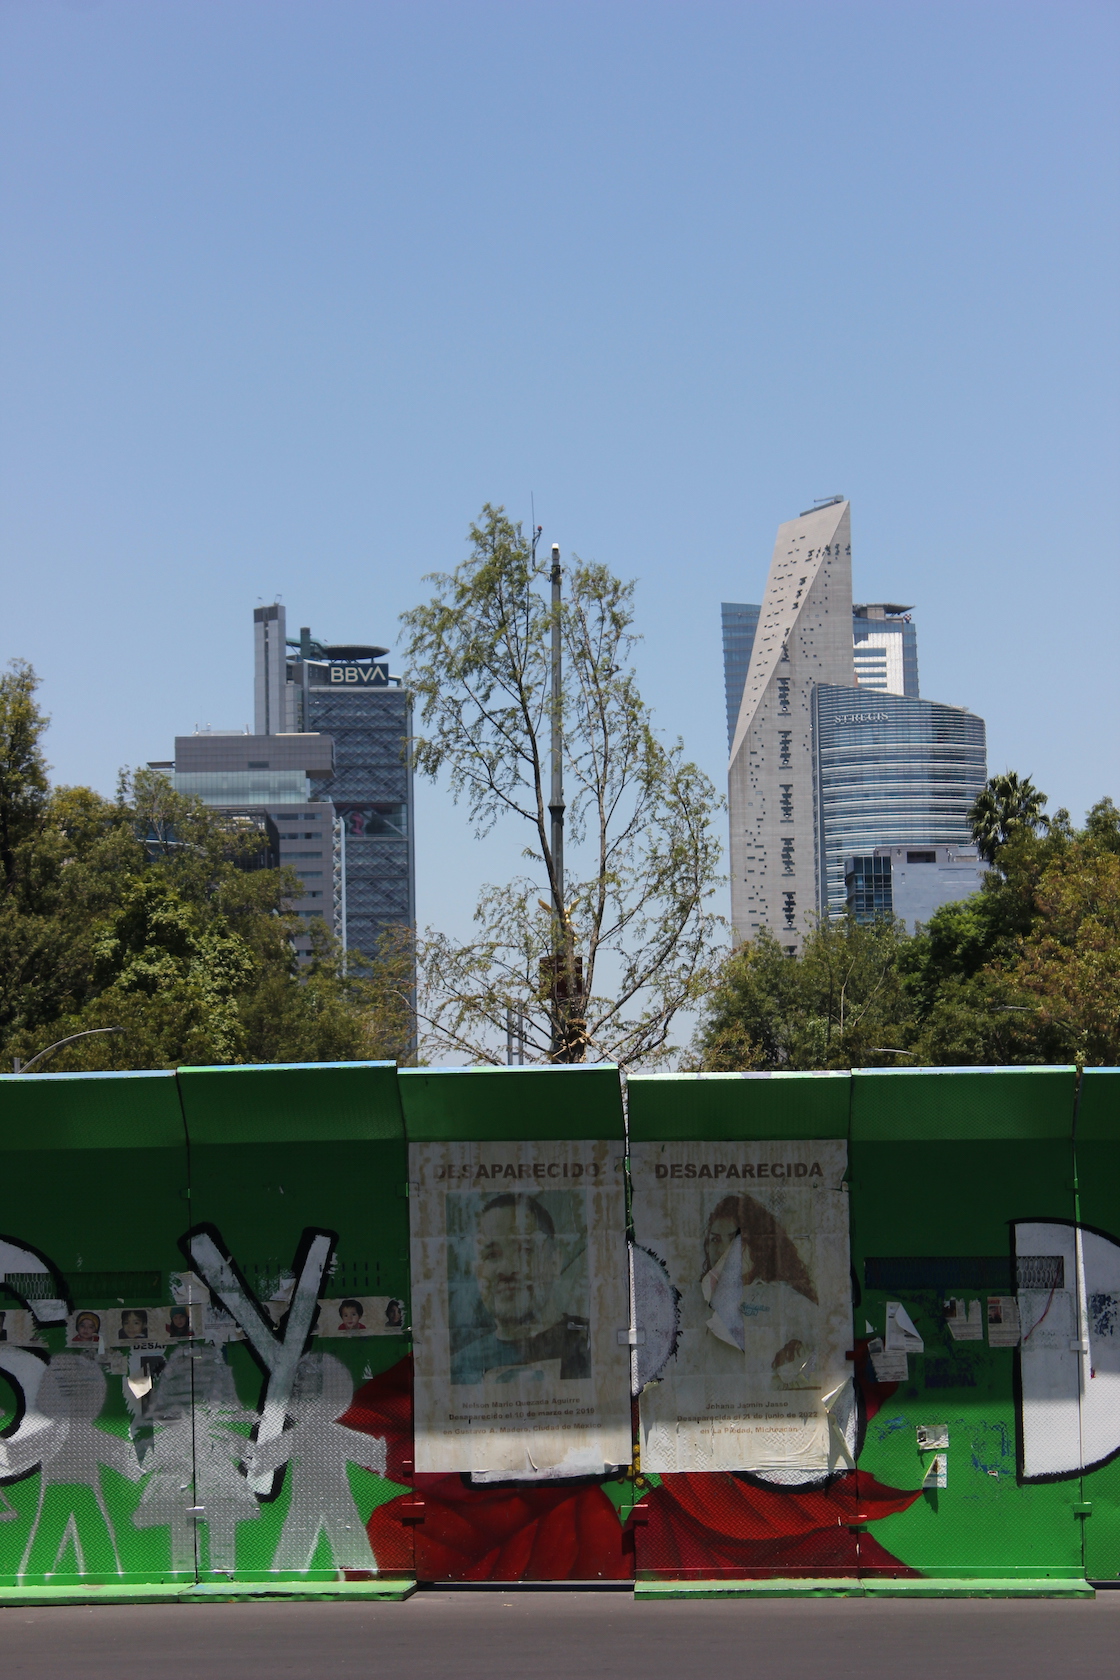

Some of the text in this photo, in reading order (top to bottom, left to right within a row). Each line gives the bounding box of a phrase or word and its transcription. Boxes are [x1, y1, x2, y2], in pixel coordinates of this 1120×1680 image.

[331, 666, 386, 682] BBVA
[851, 712, 889, 722] REGIS
[435, 1163, 600, 1179] DESAPARECIDO
[655, 1162, 823, 1179] DESAPARECIDA
[552, 1397, 581, 1405] Aguirre
[449, 1412, 503, 1421] Desaparecido
[563, 1407, 574, 1415] de
[678, 1414, 731, 1423] Desaparecida
[765, 1412, 785, 1420] junio
[533, 1423, 560, 1432] Ciudad
